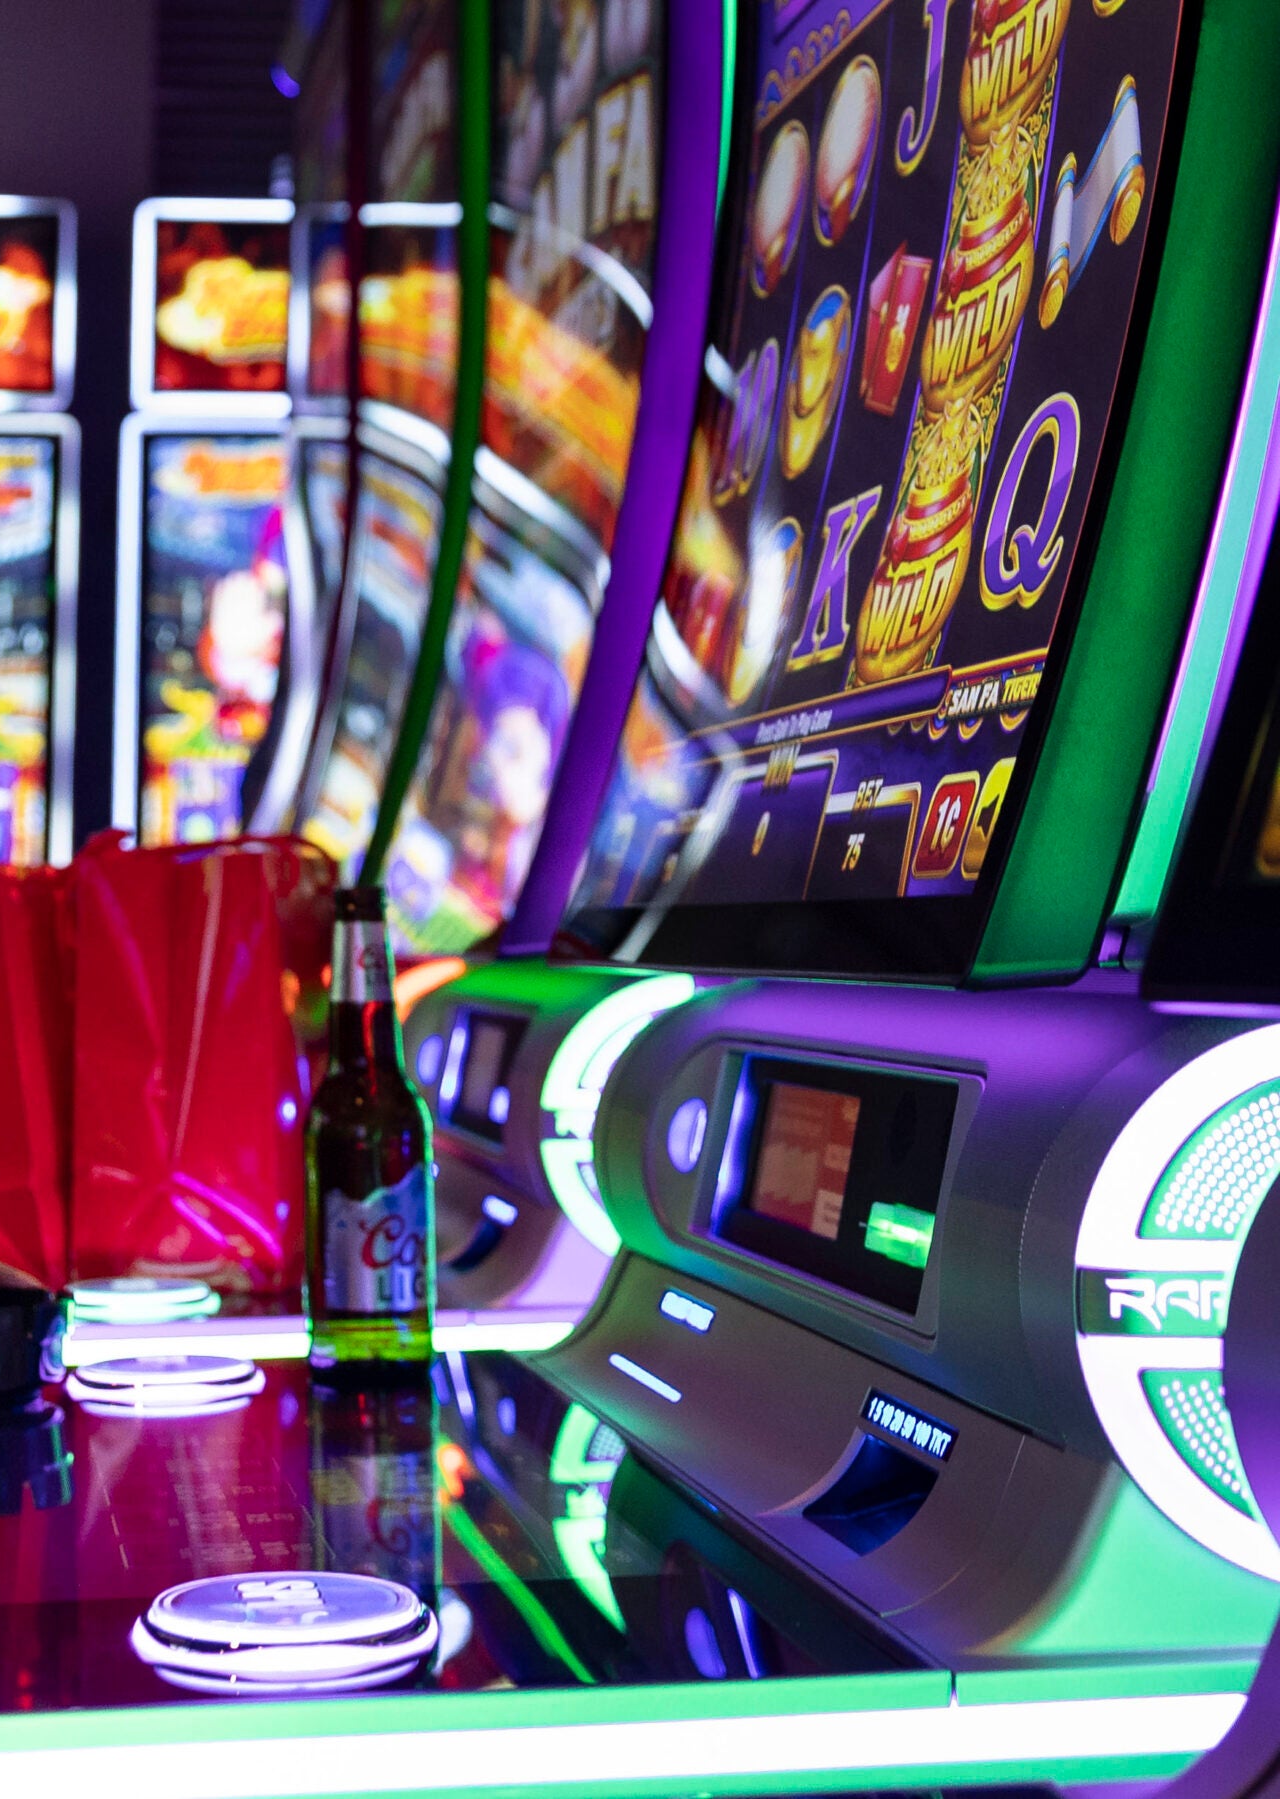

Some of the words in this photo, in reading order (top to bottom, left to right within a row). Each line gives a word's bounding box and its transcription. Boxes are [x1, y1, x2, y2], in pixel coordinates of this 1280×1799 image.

[971, 0, 1058, 123] WILD
[930, 263, 1021, 386] WILD
[979, 391, 1081, 611] Q
[784, 484, 883, 672] K
[863, 549, 959, 654] WILD
[948, 684, 982, 717] SAN
[978, 680, 1001, 711] FA
[853, 777, 884, 810] BET
[841, 832, 866, 872] 75
[868, 1397, 878, 1419] 1
[873, 1400, 885, 1422] 5
